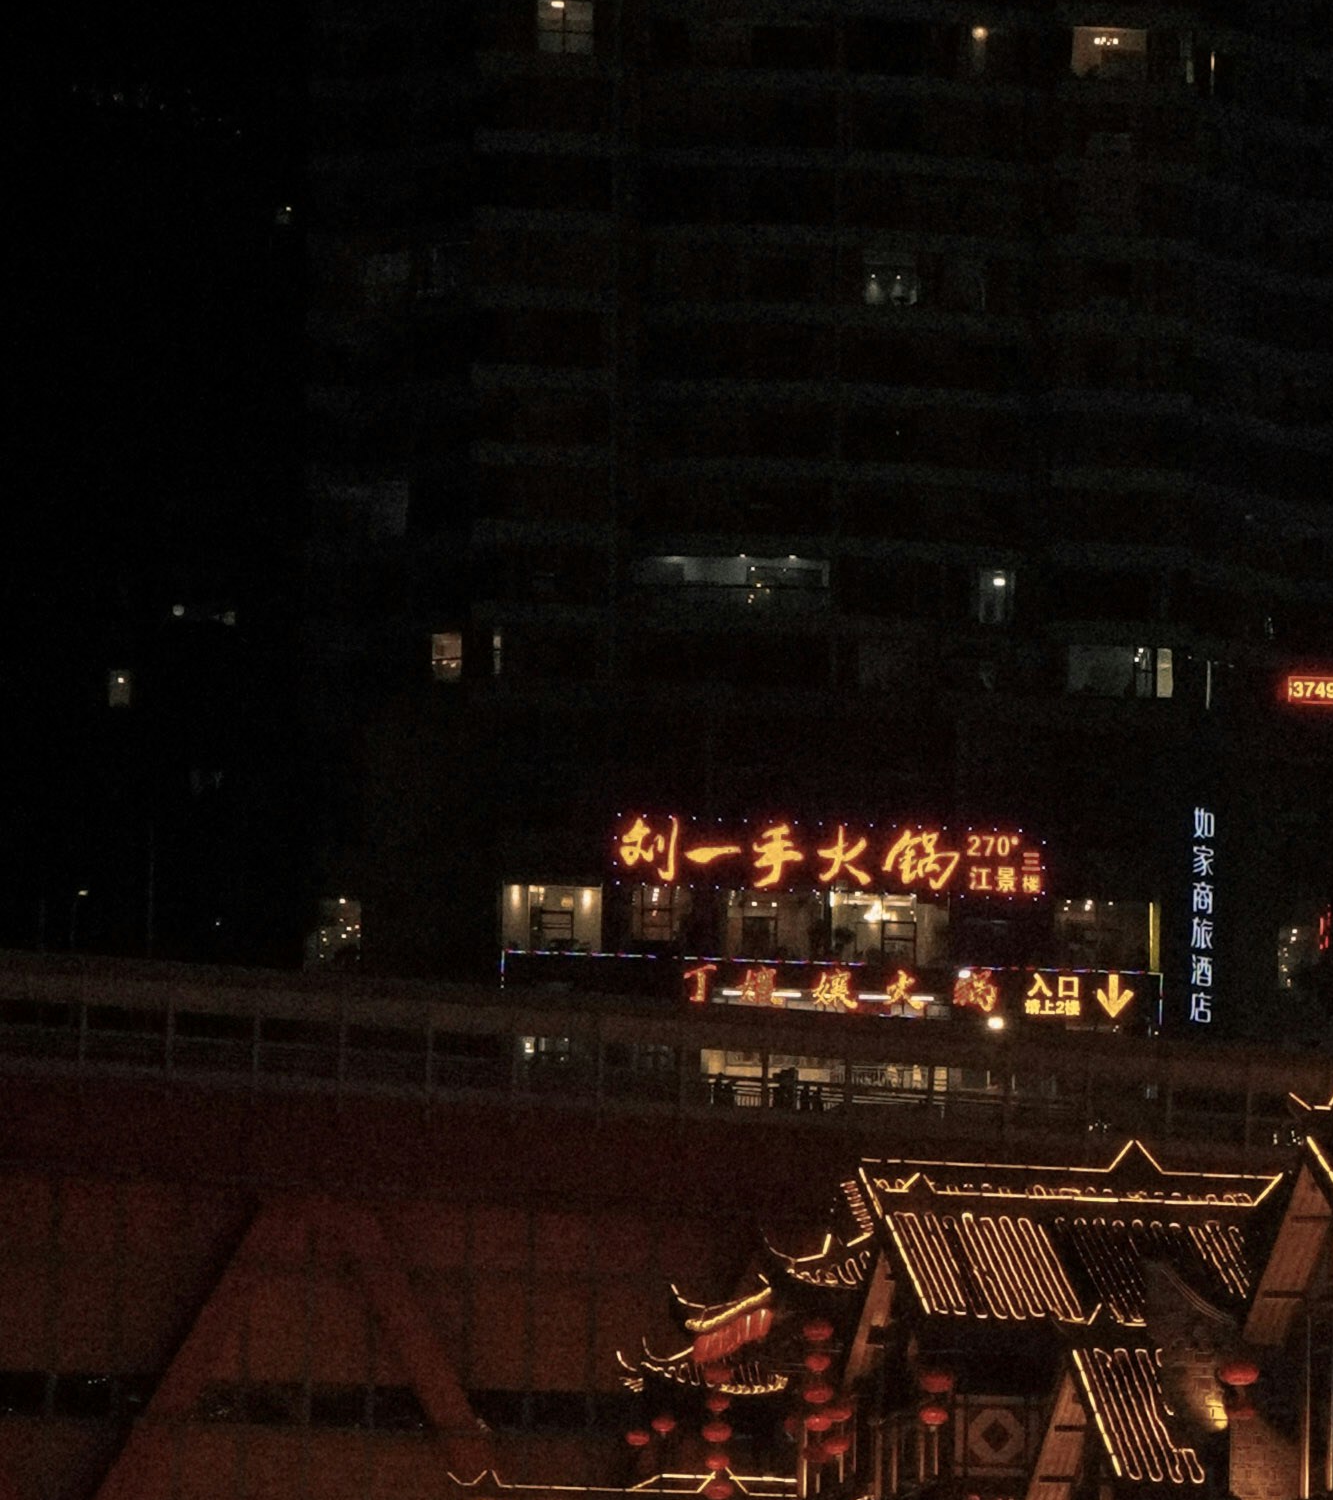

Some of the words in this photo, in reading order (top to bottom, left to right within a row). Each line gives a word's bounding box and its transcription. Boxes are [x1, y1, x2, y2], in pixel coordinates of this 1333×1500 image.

[620, 816, 960, 891] 刘一手火锅
[970, 866, 1019, 892] 江景
[1189, 807, 1215, 1024] 如家商旅酒店
[1026, 972, 1080, 998] 入口
